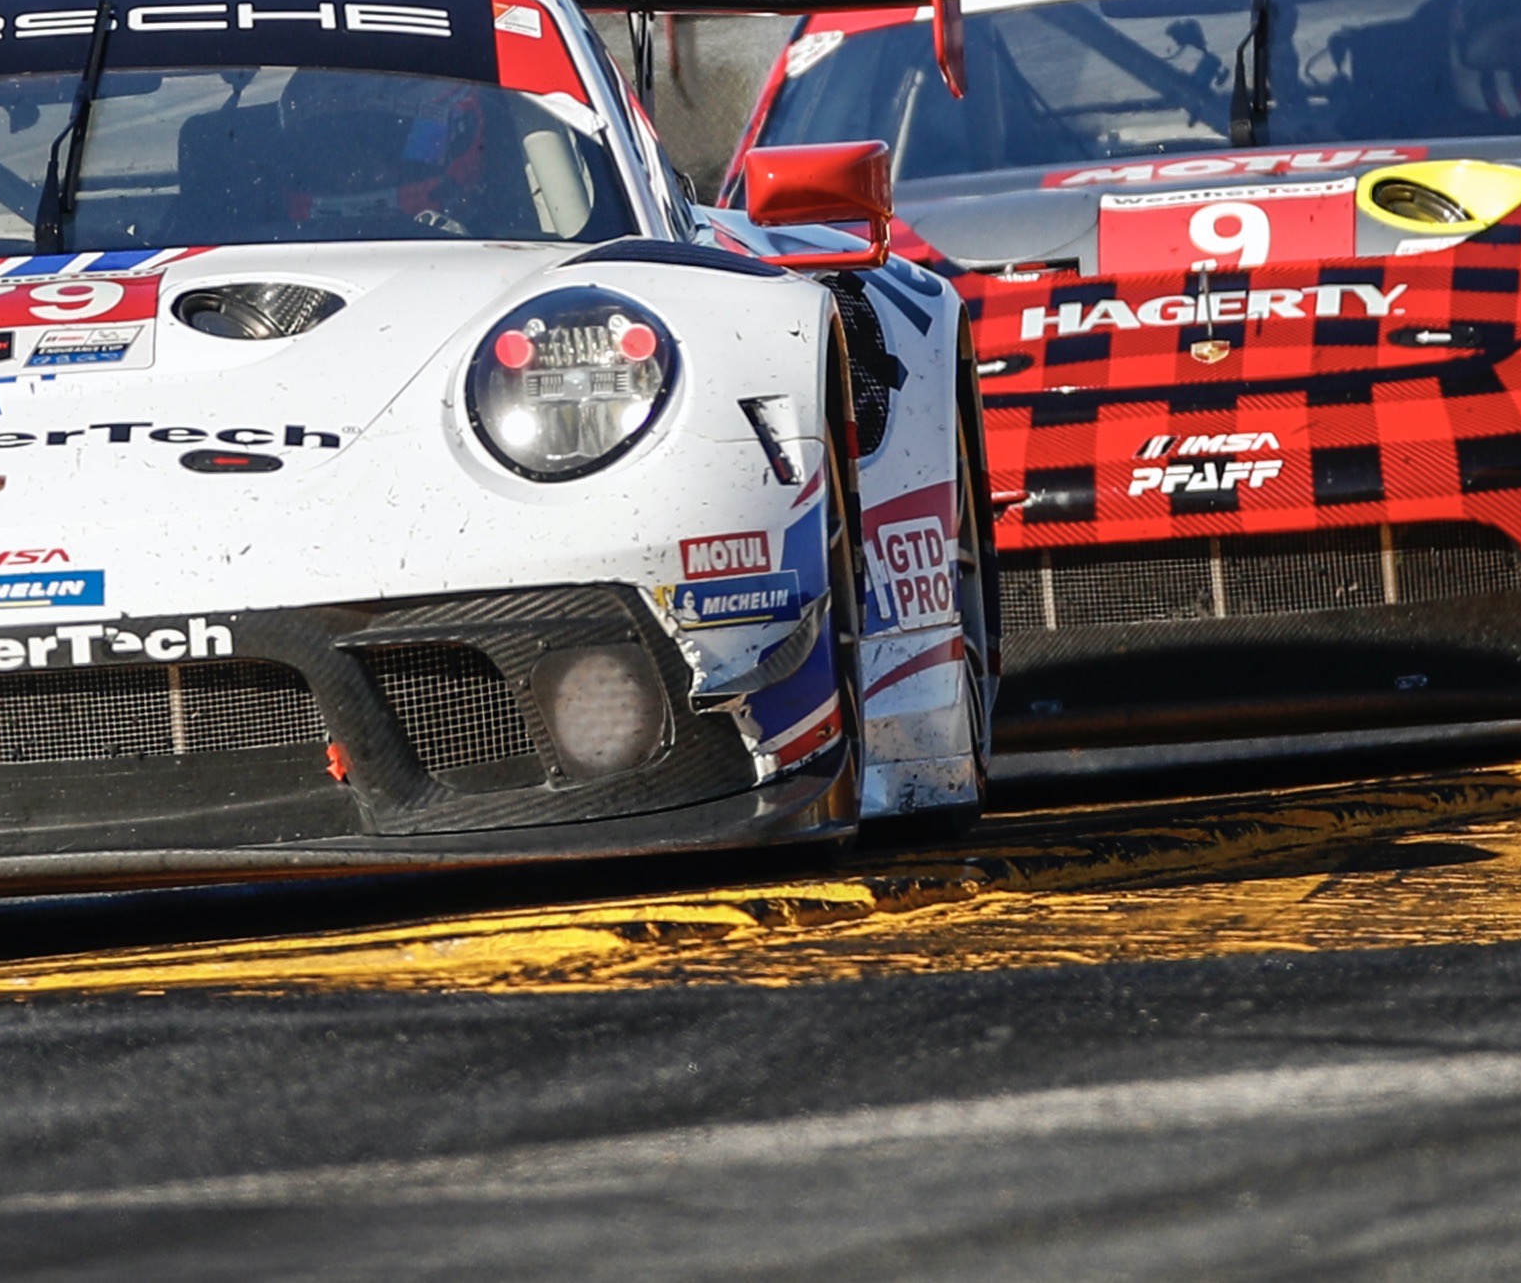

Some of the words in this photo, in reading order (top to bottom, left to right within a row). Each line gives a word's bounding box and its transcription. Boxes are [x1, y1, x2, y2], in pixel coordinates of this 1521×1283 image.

[1060, 149, 1409, 186] MOTUL
[1189, 202, 1271, 272] 9
[1021, 284, 1407, 340] HAGERTY
[1179, 432, 1280, 455] IMSA
[1128, 459, 1283, 497] PFAFF
[685, 536, 767, 577] MOTUL
[887, 529, 944, 574] GTD
[703, 586, 789, 616] MICHELIN
[896, 572, 950, 618] PRO
